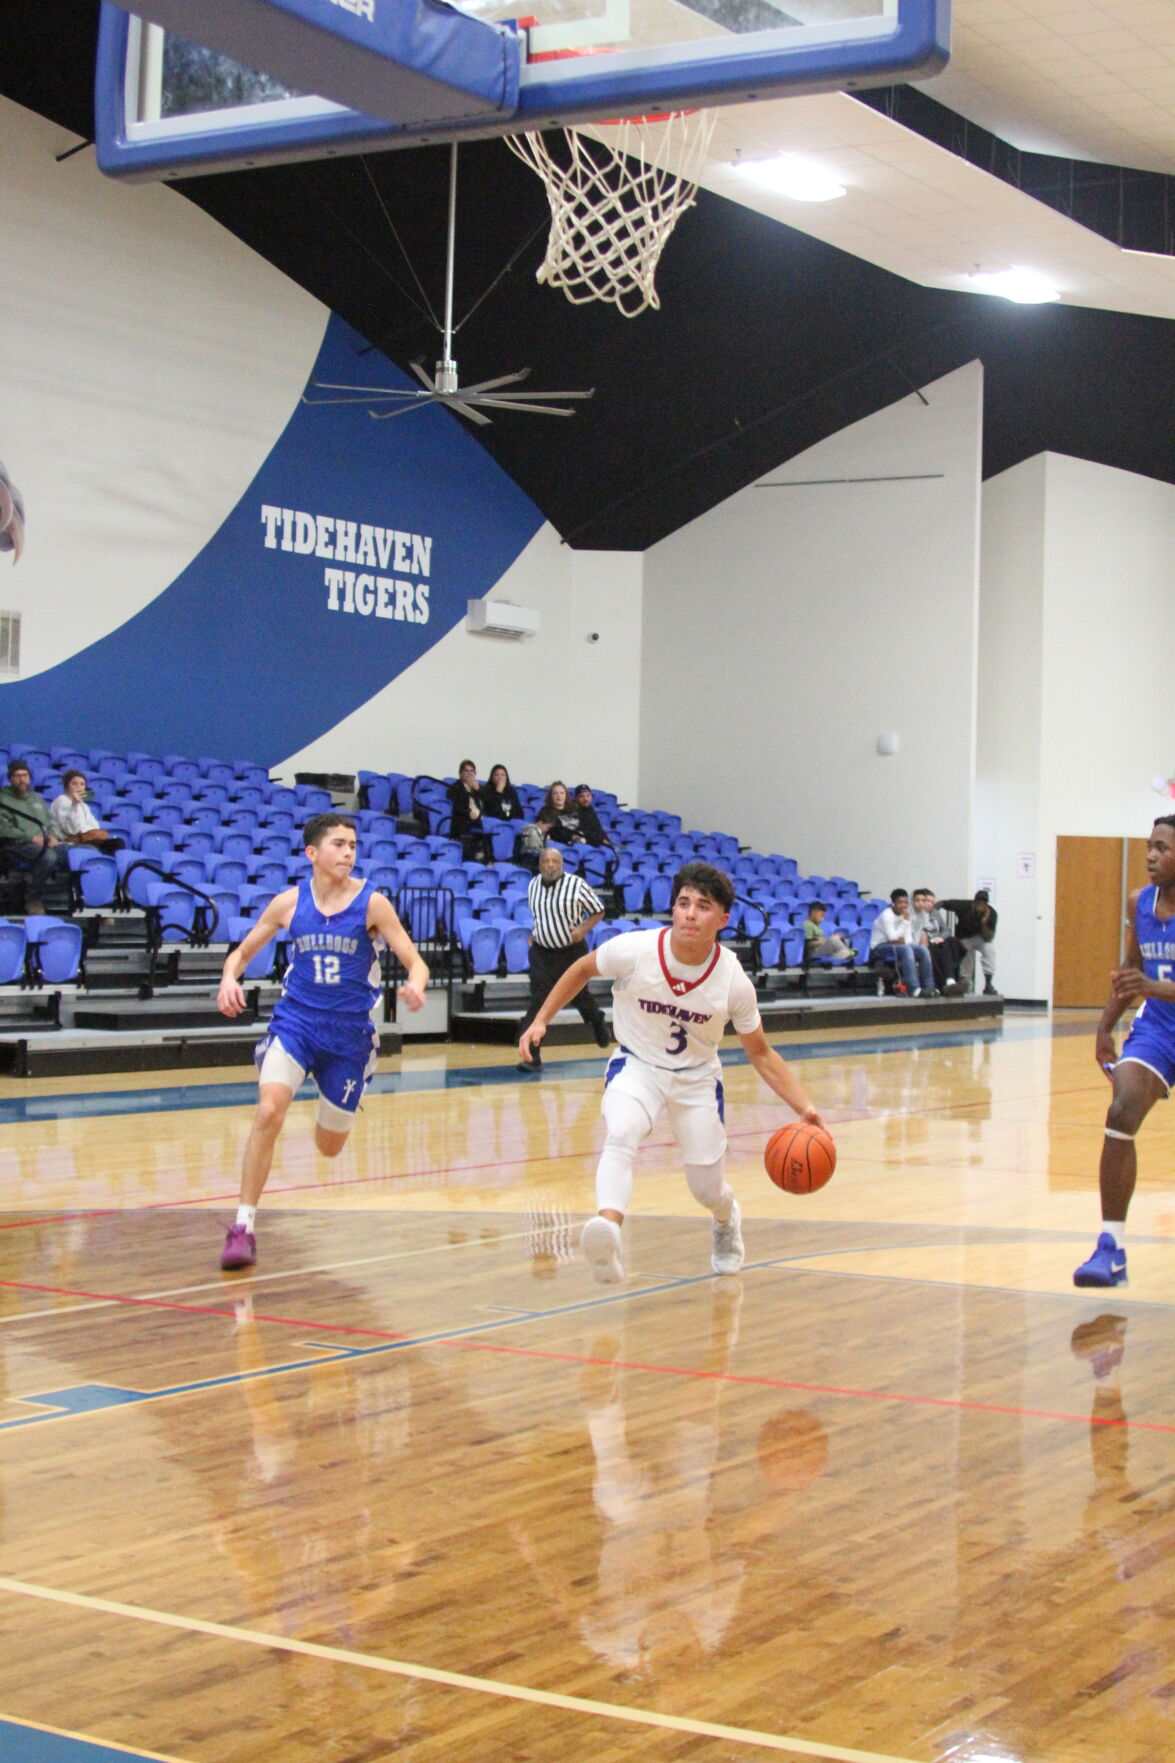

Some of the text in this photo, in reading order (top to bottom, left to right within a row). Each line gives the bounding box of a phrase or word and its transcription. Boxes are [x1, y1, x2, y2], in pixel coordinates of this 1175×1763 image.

[261, 504, 432, 577] TIDEHAVEN
[324, 567, 430, 625] TIGERS
[312, 954, 341, 984] 12
[665, 1021, 688, 1056] 3
